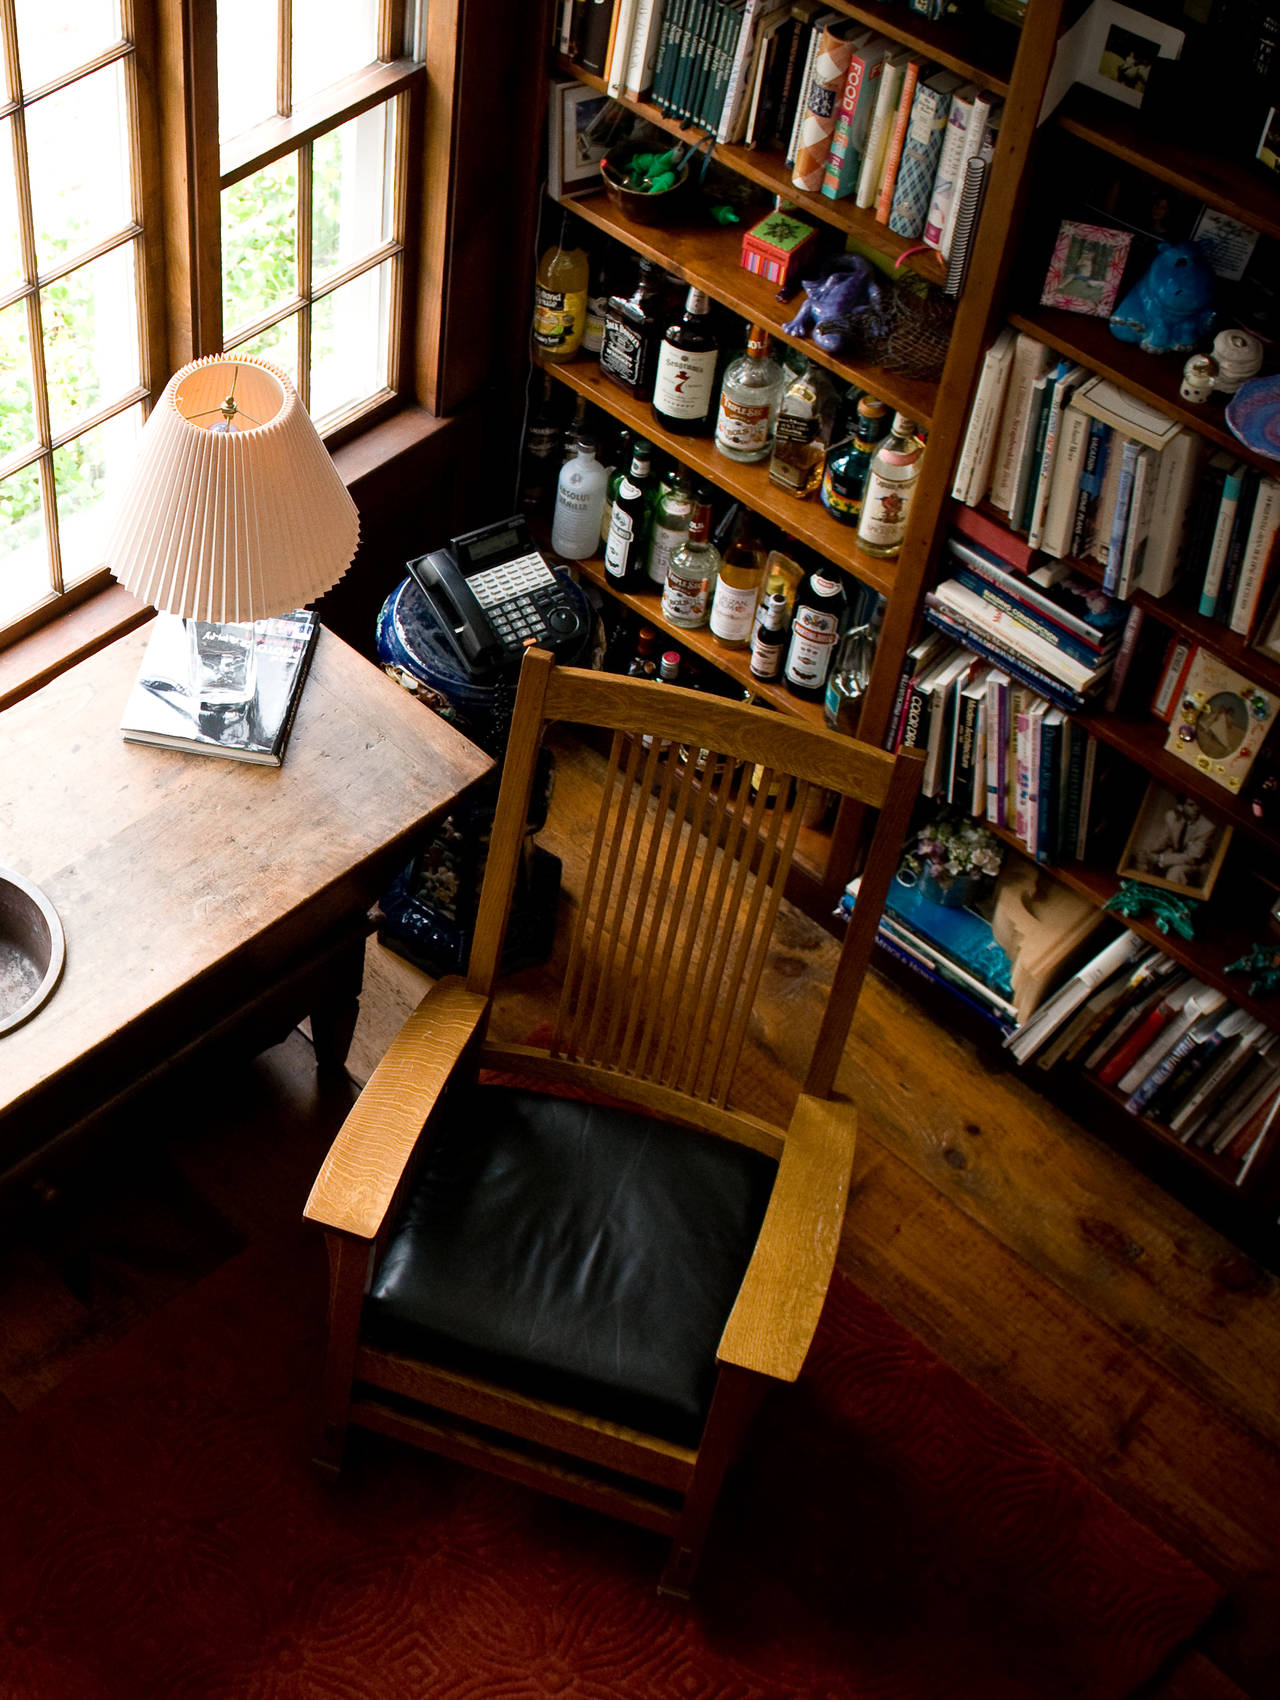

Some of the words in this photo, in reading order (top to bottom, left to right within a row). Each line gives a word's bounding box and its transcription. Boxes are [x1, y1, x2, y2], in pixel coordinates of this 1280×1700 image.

[843, 62, 862, 111] FOOD
[559, 485, 590, 501] ABSOLUT
[907, 695, 922, 727] COLOR
